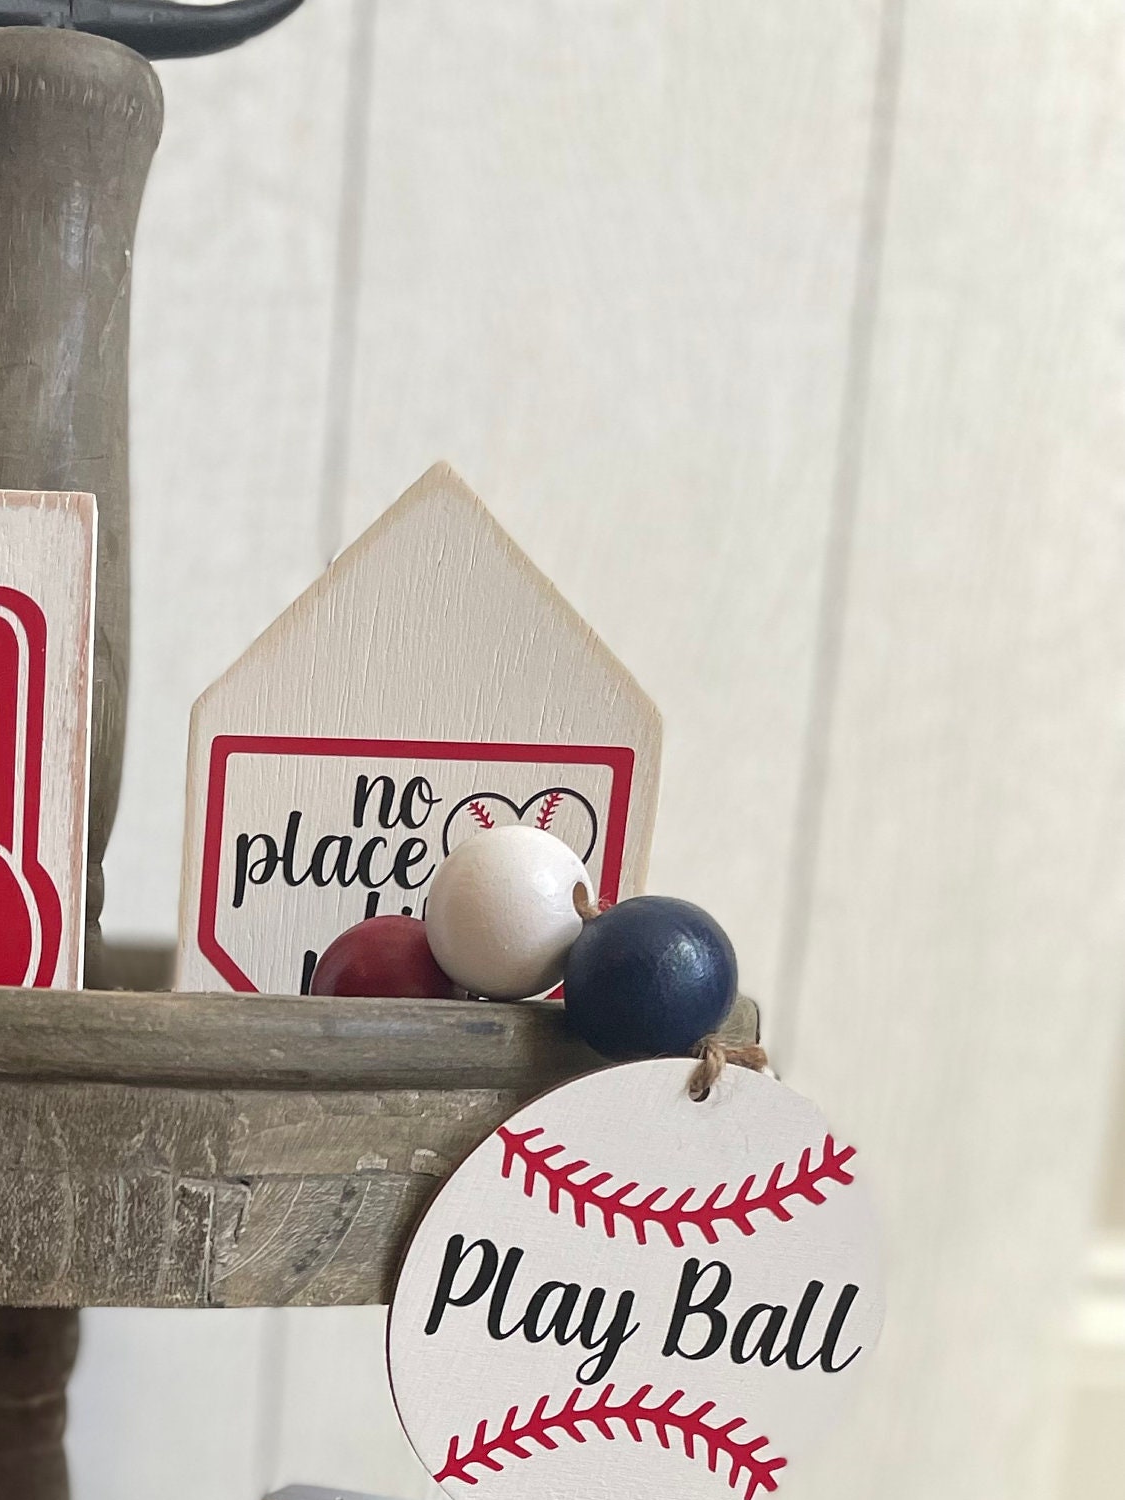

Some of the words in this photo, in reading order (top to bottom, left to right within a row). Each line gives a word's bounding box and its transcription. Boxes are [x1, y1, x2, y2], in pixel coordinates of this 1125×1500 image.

[353, 775, 442, 829] no
[232, 811, 435, 908] place
[424, 1233, 641, 1385] Play
[661, 1257, 862, 1373] Ball
